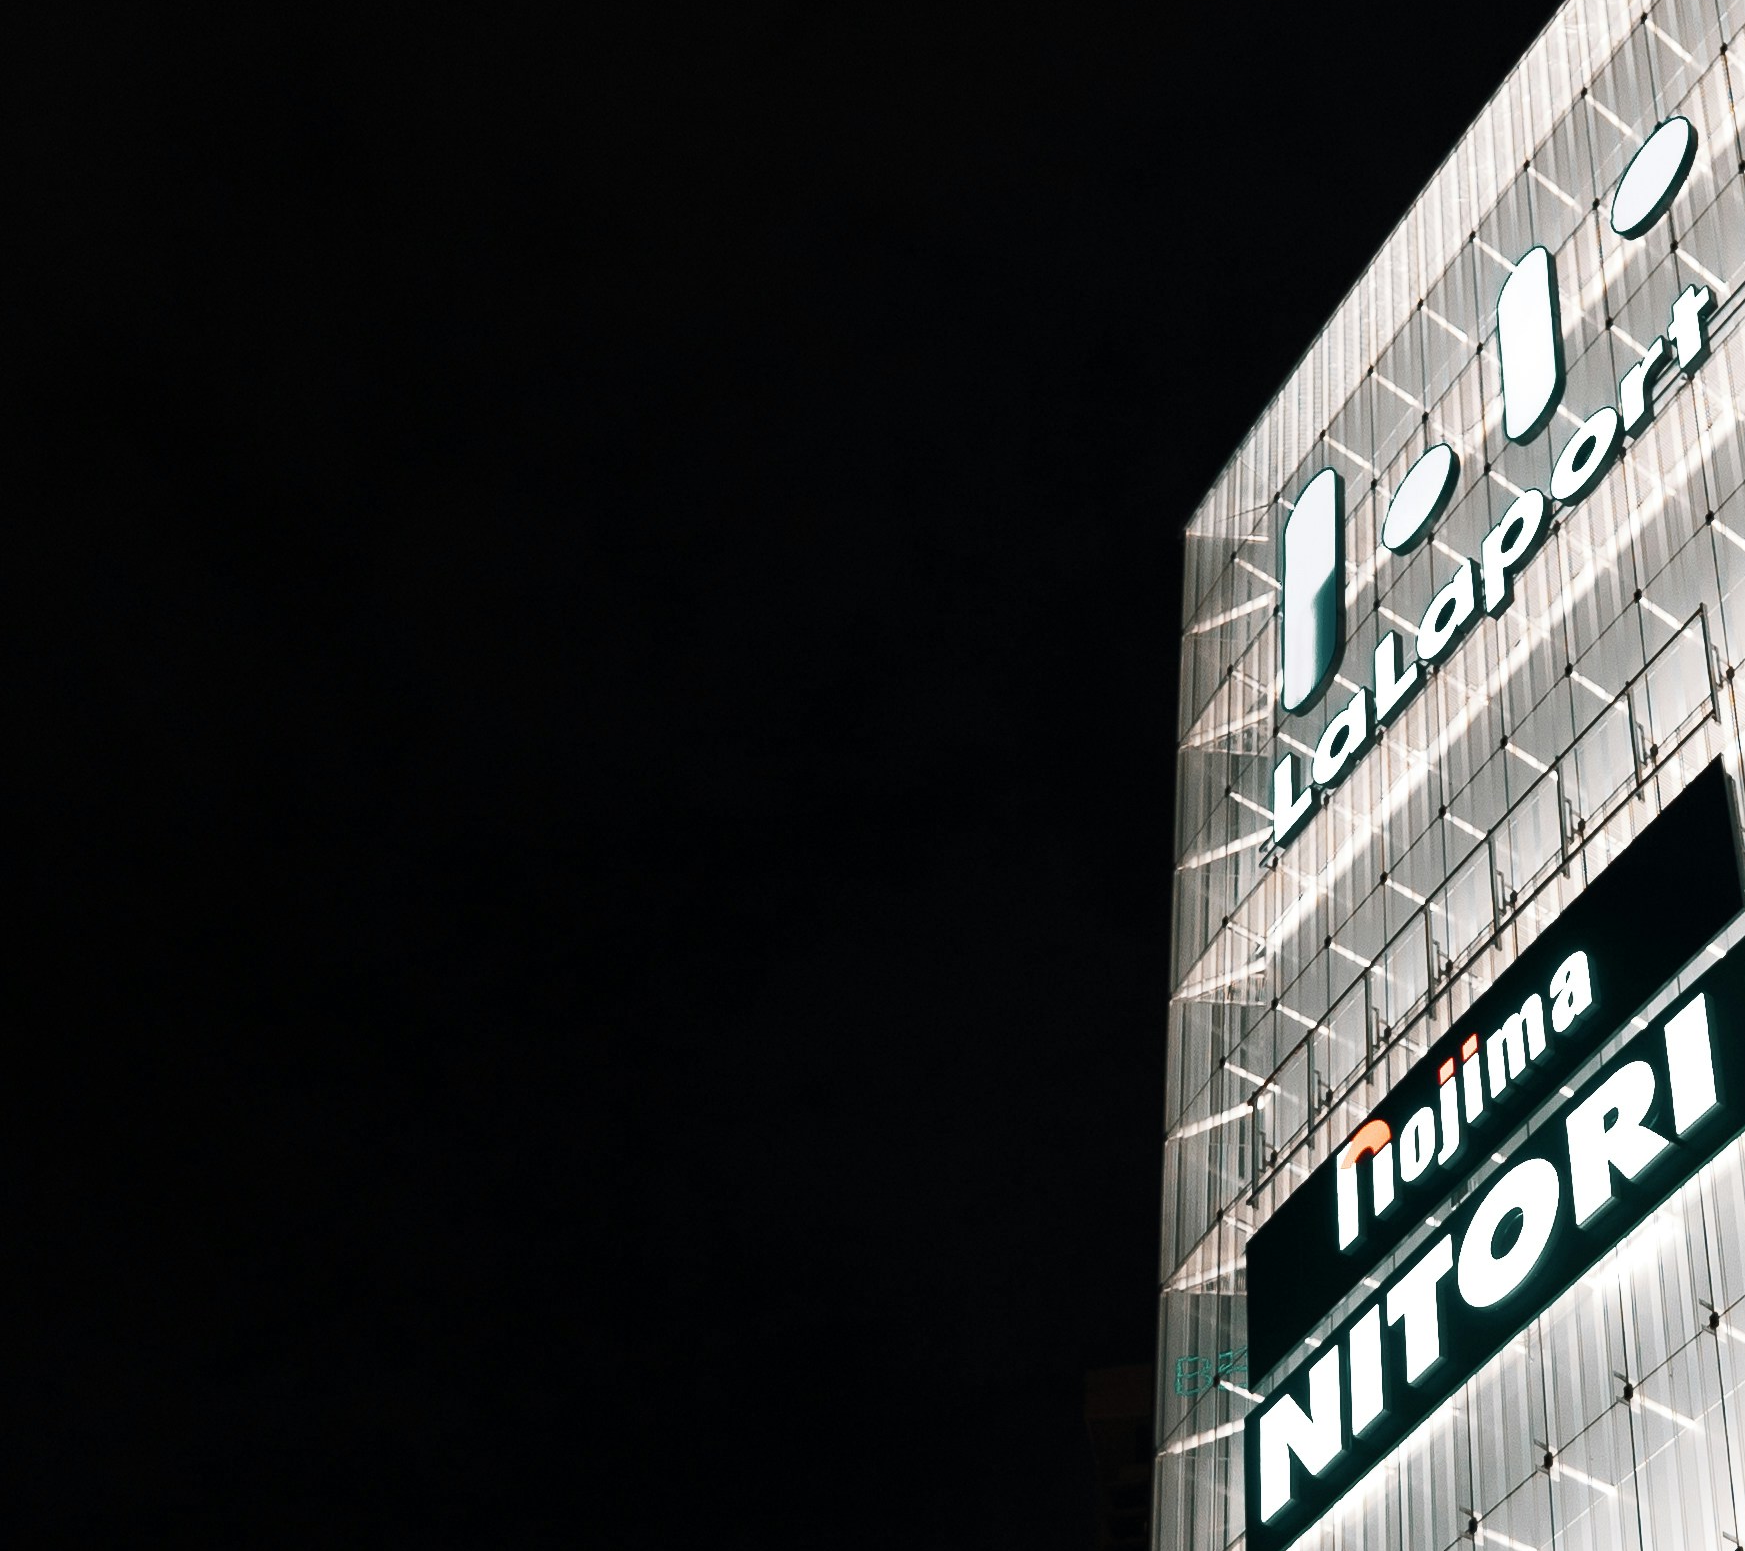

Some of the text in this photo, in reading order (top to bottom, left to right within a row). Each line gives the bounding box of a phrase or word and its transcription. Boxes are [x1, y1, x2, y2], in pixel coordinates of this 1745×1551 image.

[1273, 284, 1712, 845] LaLaport
[1259, 992, 1719, 1524] NITORI
[1335, 950, 1594, 1251] nojima
